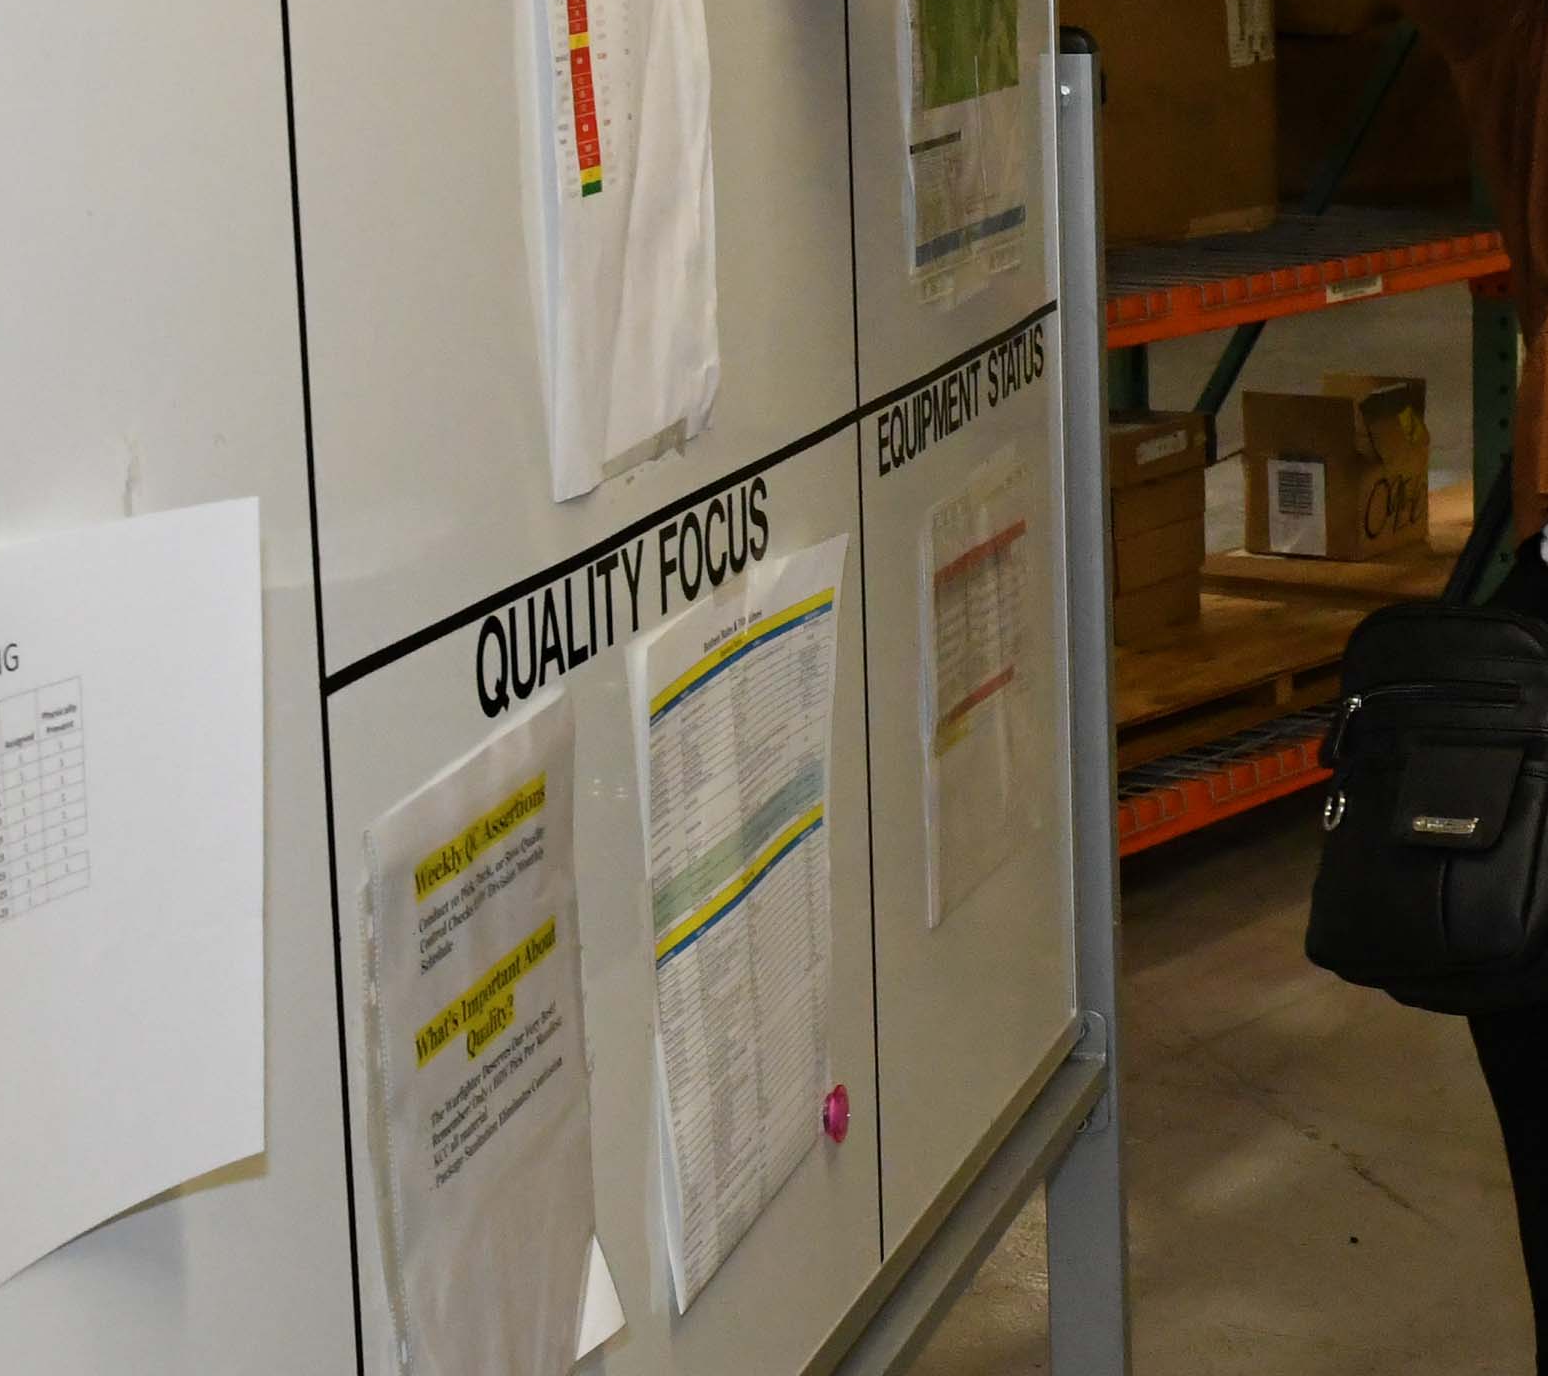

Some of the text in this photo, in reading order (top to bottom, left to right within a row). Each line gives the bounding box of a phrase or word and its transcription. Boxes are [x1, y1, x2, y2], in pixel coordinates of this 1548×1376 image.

[877, 322, 1045, 477] EQUIPMENT STATUS
[476, 539, 645, 718] QUALITY
[657, 476, 769, 616] FOCUS
[413, 845, 462, 896] Weekly
[414, 926, 557, 1061] What's Important About
[466, 993, 515, 1058] Quality?
